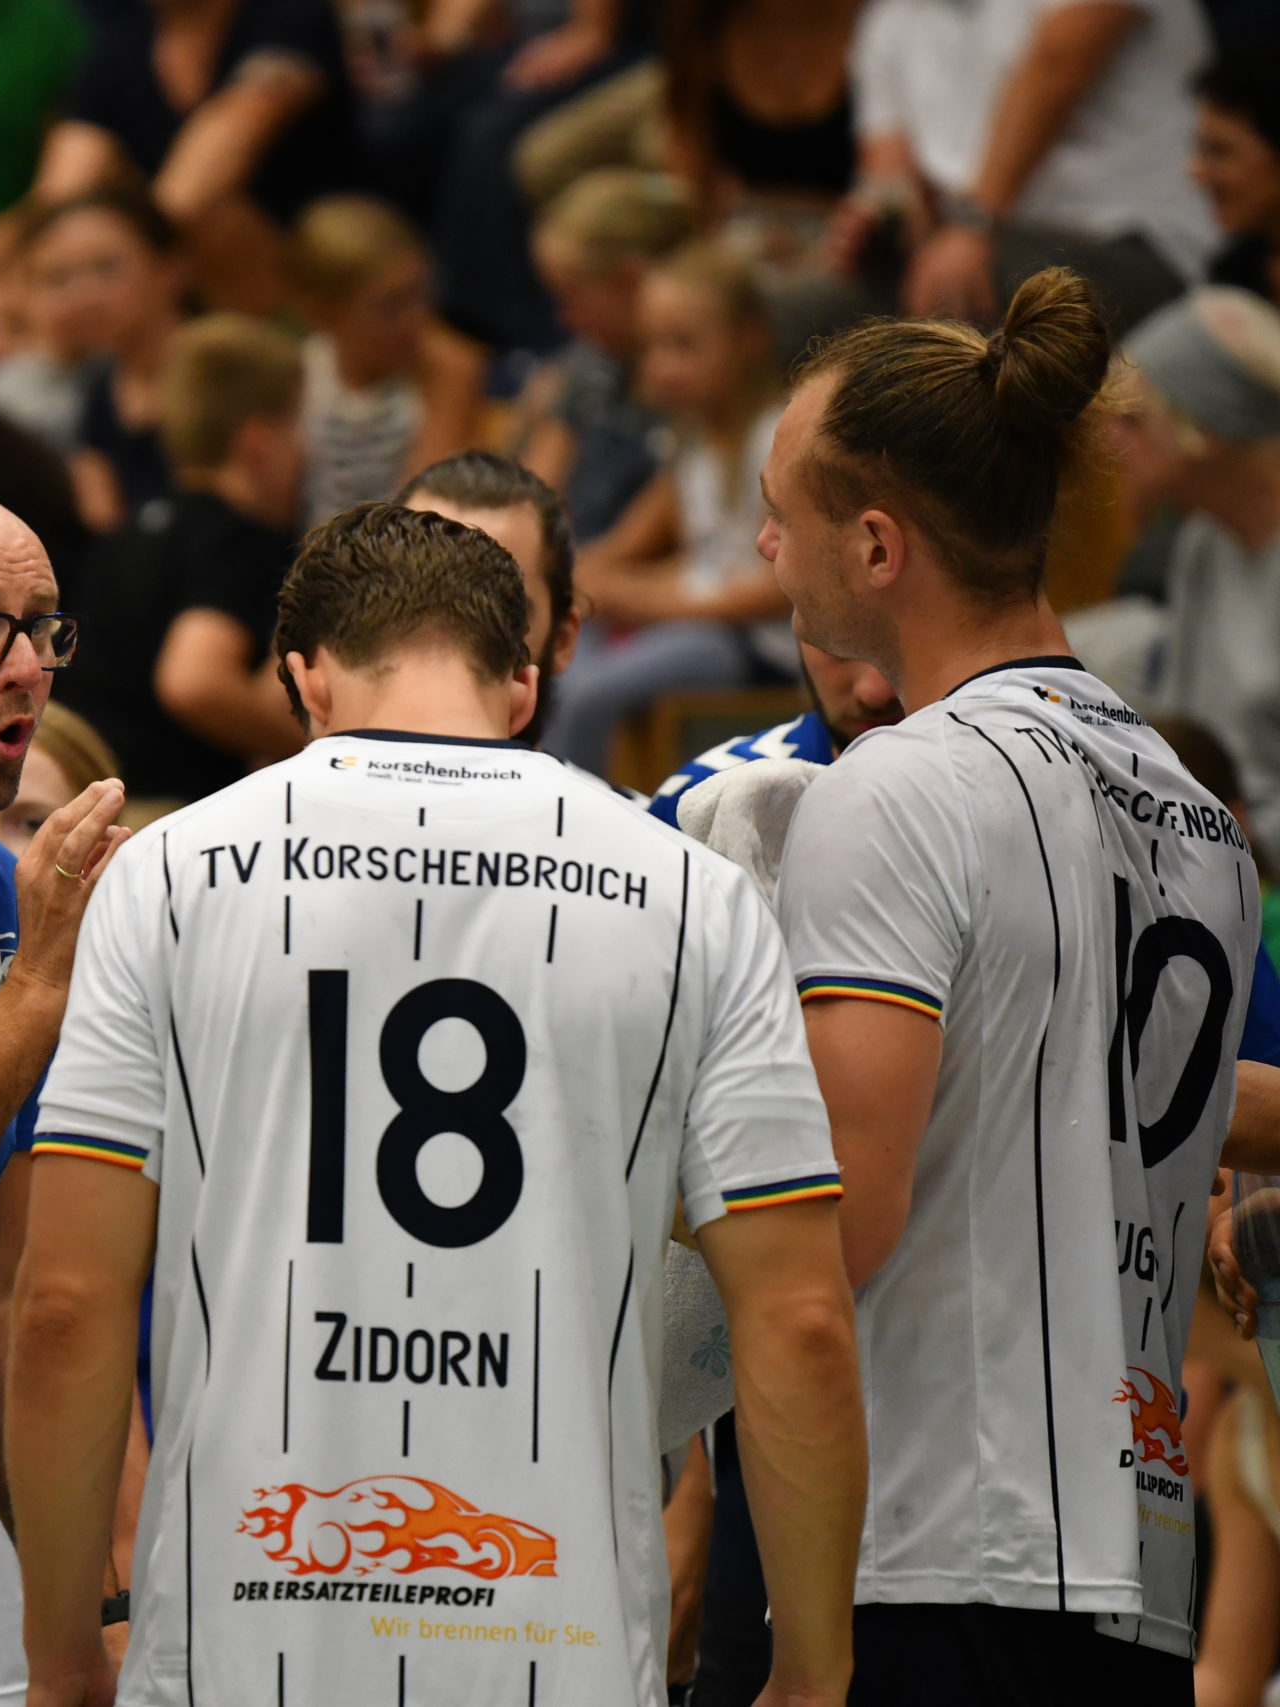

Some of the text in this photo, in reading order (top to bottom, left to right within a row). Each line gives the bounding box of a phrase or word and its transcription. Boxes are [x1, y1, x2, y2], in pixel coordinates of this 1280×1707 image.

[368, 760, 522, 781] Korschenbroich
[201, 837, 647, 909] TV KORSCHENBROICH
[306, 969, 527, 1249] 18
[314, 1311, 510, 1389] ZIDORN
[233, 1581, 496, 1608] DER ERSATZTEILEPROFI
[370, 1616, 603, 1647] Wir brennen für Sie.
